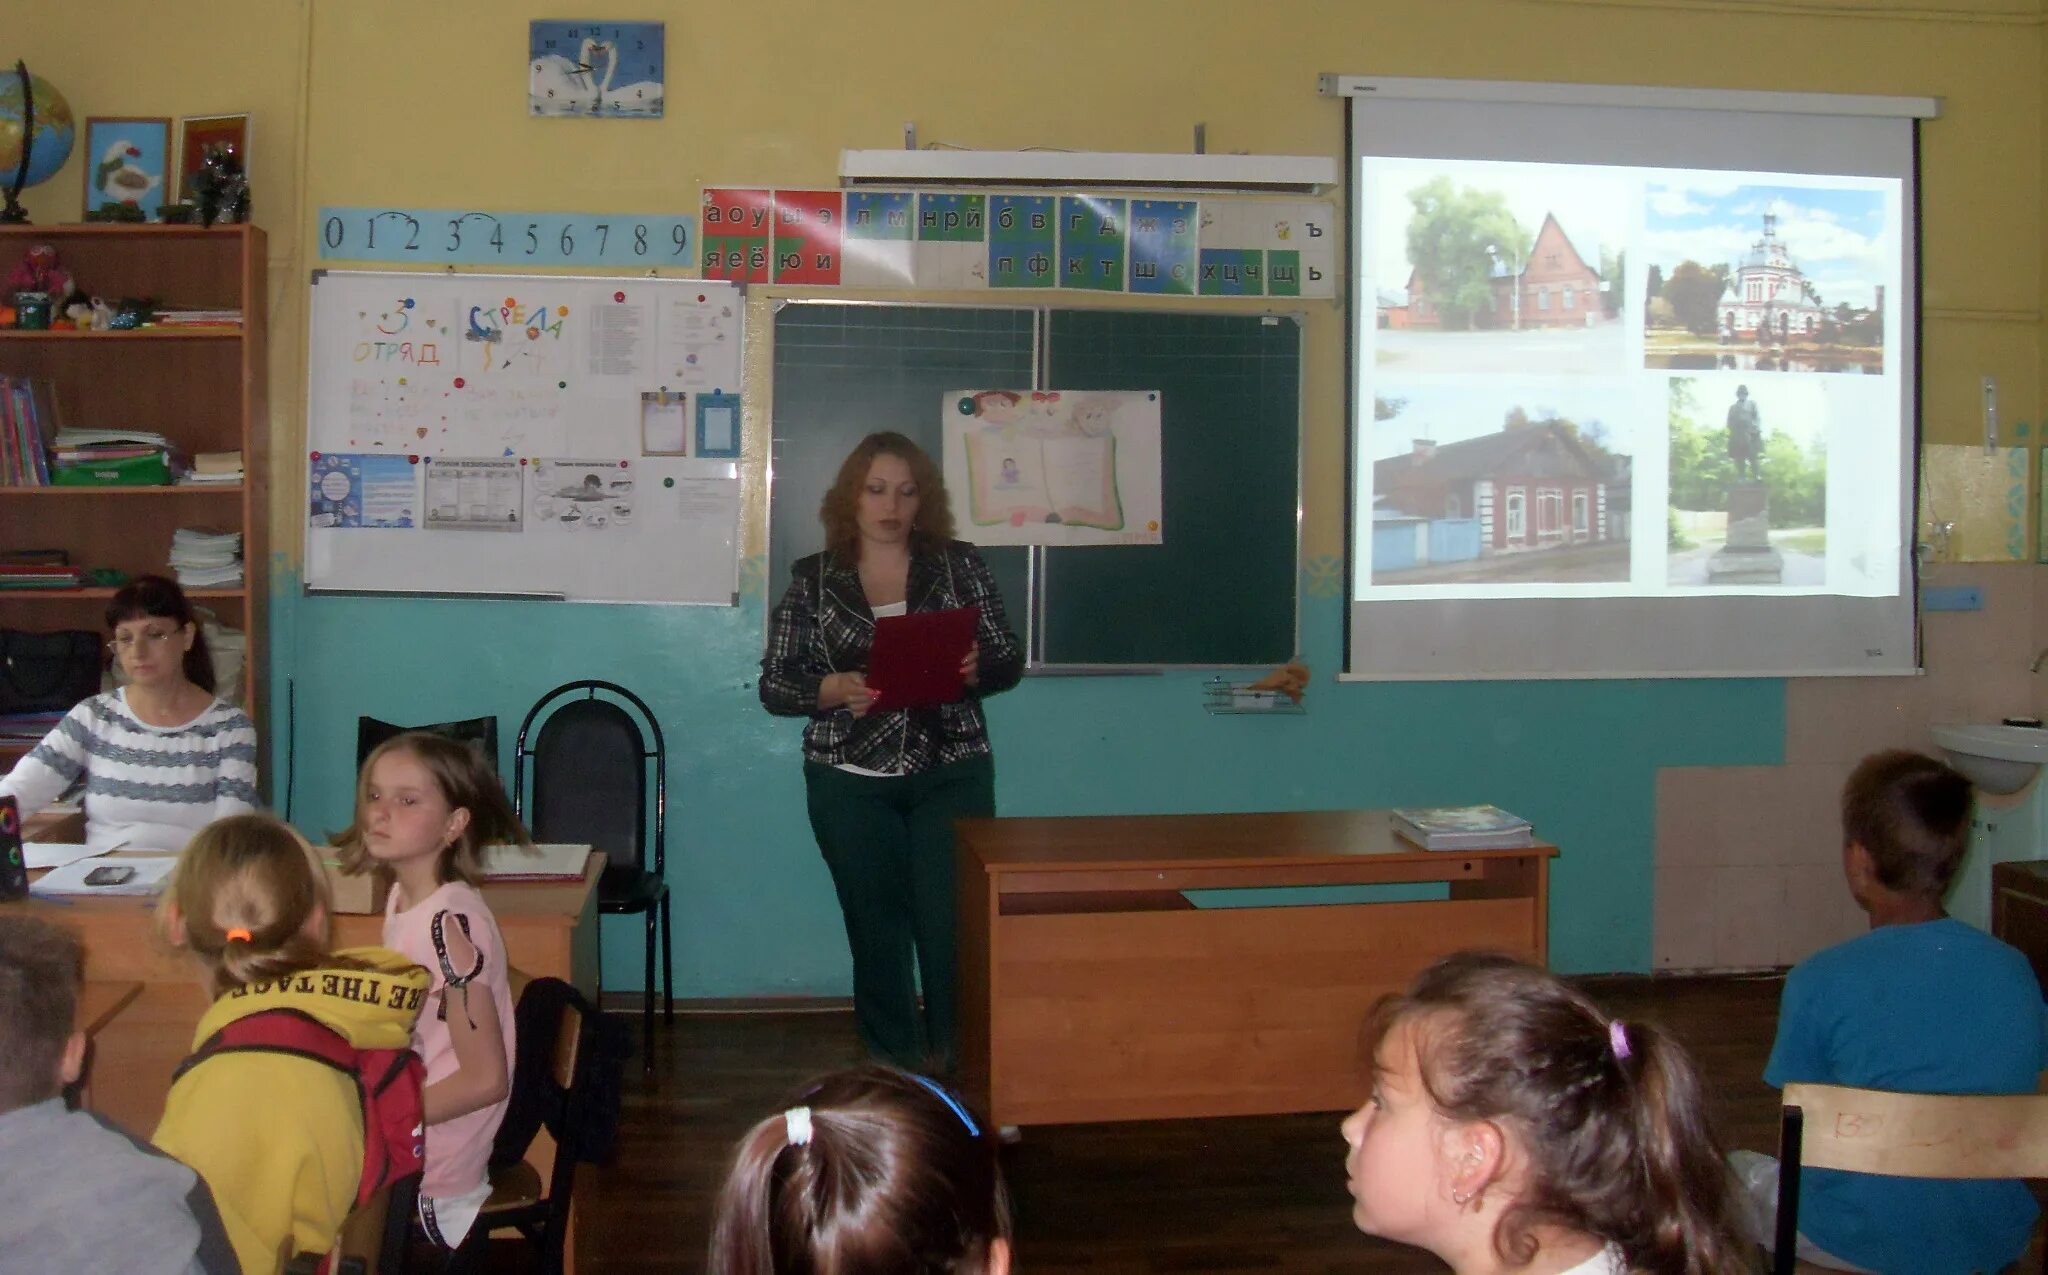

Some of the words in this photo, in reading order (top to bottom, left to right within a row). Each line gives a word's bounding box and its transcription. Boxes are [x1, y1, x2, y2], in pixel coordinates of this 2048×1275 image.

[590, 26, 601, 36] 12
[536, 64, 542, 73] 9
[548, 89, 554, 98] 8
[570, 101, 576, 112] 7
[324, 216, 344, 248] 0
[366, 217, 376, 248] 1
[404, 218, 420, 250] 2
[446, 220, 462, 252] 3
[490, 222, 504, 254] 4
[525, 224, 538, 254] 5
[560, 224, 574, 256] 6
[595, 224, 608, 256] 7
[634, 224, 648, 256] 8
[672, 224, 687, 256] 9
[376, 299, 408, 335] 3
[469, 304, 563, 340] СТРЕЛА
[353, 342, 440, 367] ОТРЯД
[321, 974, 380, 1005] THE
